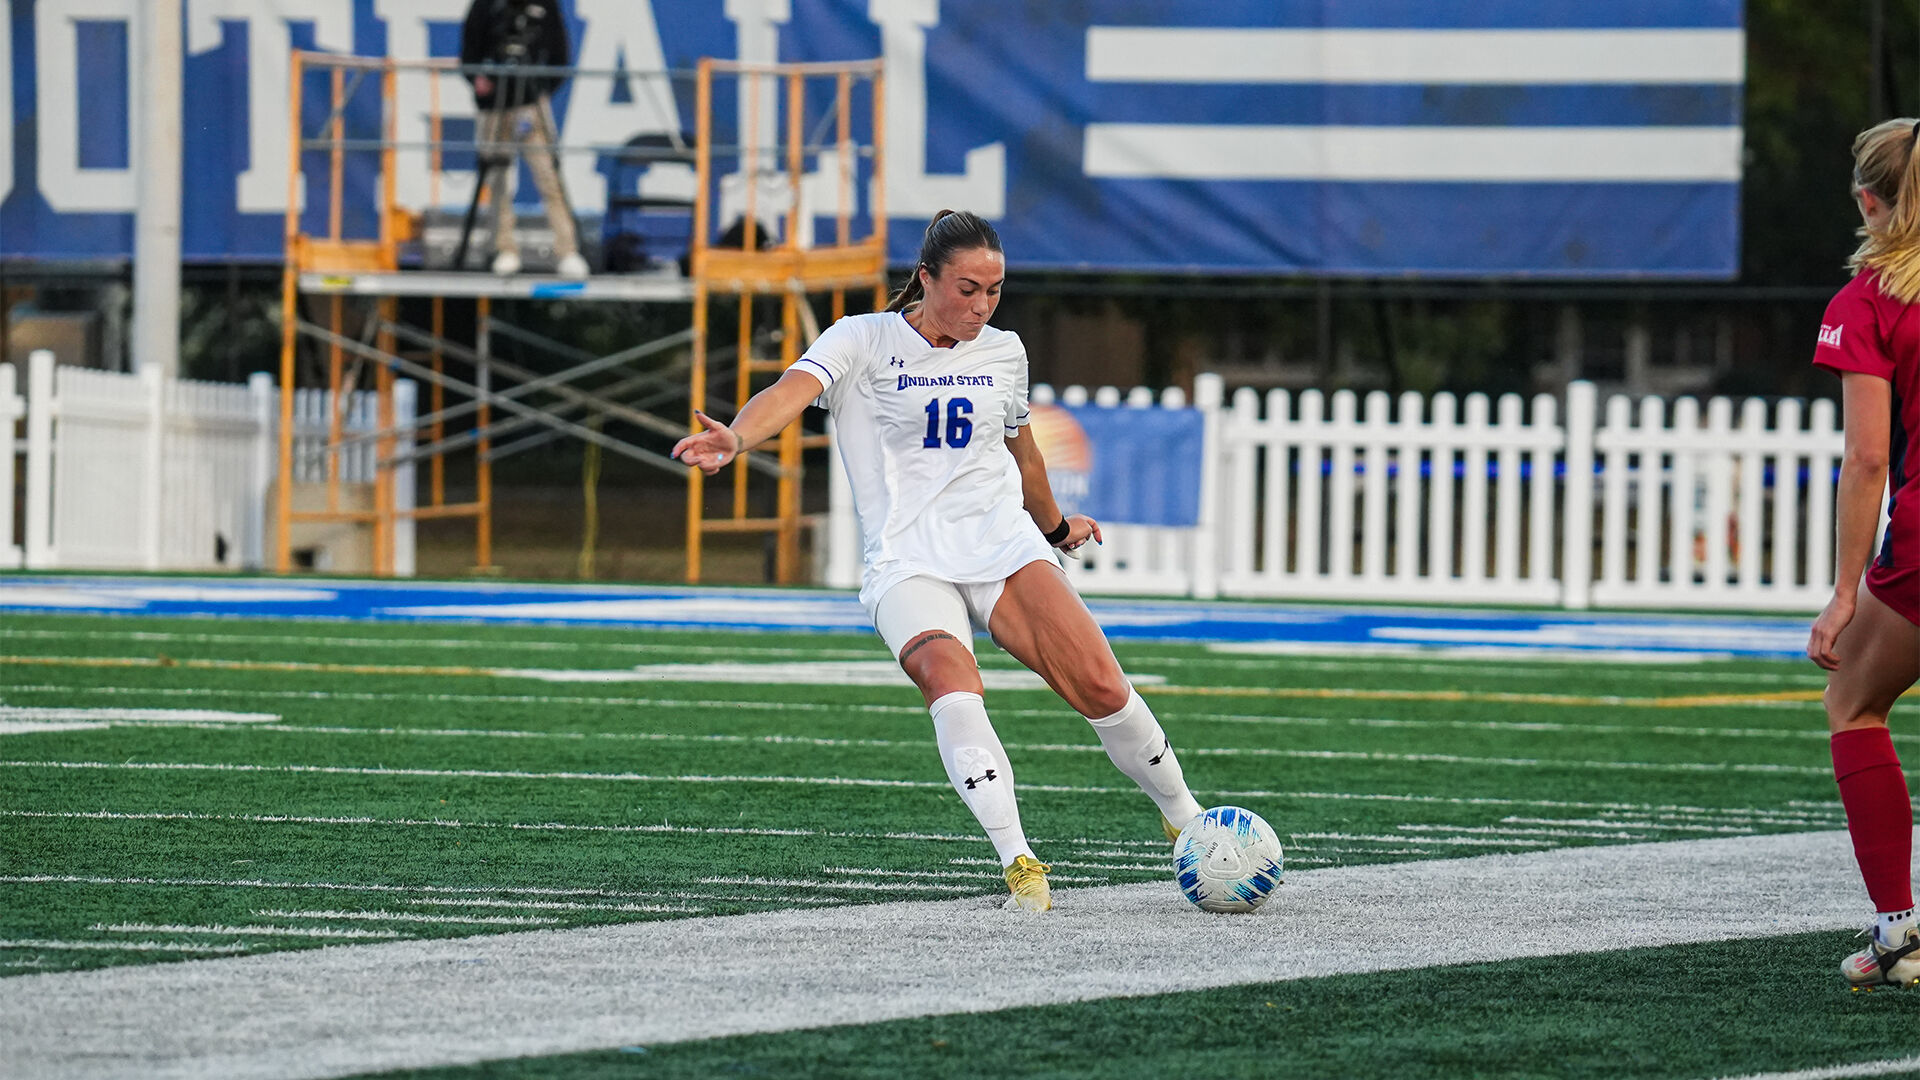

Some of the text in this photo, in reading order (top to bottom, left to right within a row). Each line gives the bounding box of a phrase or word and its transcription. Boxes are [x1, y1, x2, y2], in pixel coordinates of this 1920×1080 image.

[897, 374, 993, 391] INDIANA STATE
[923, 397, 973, 449] 16
